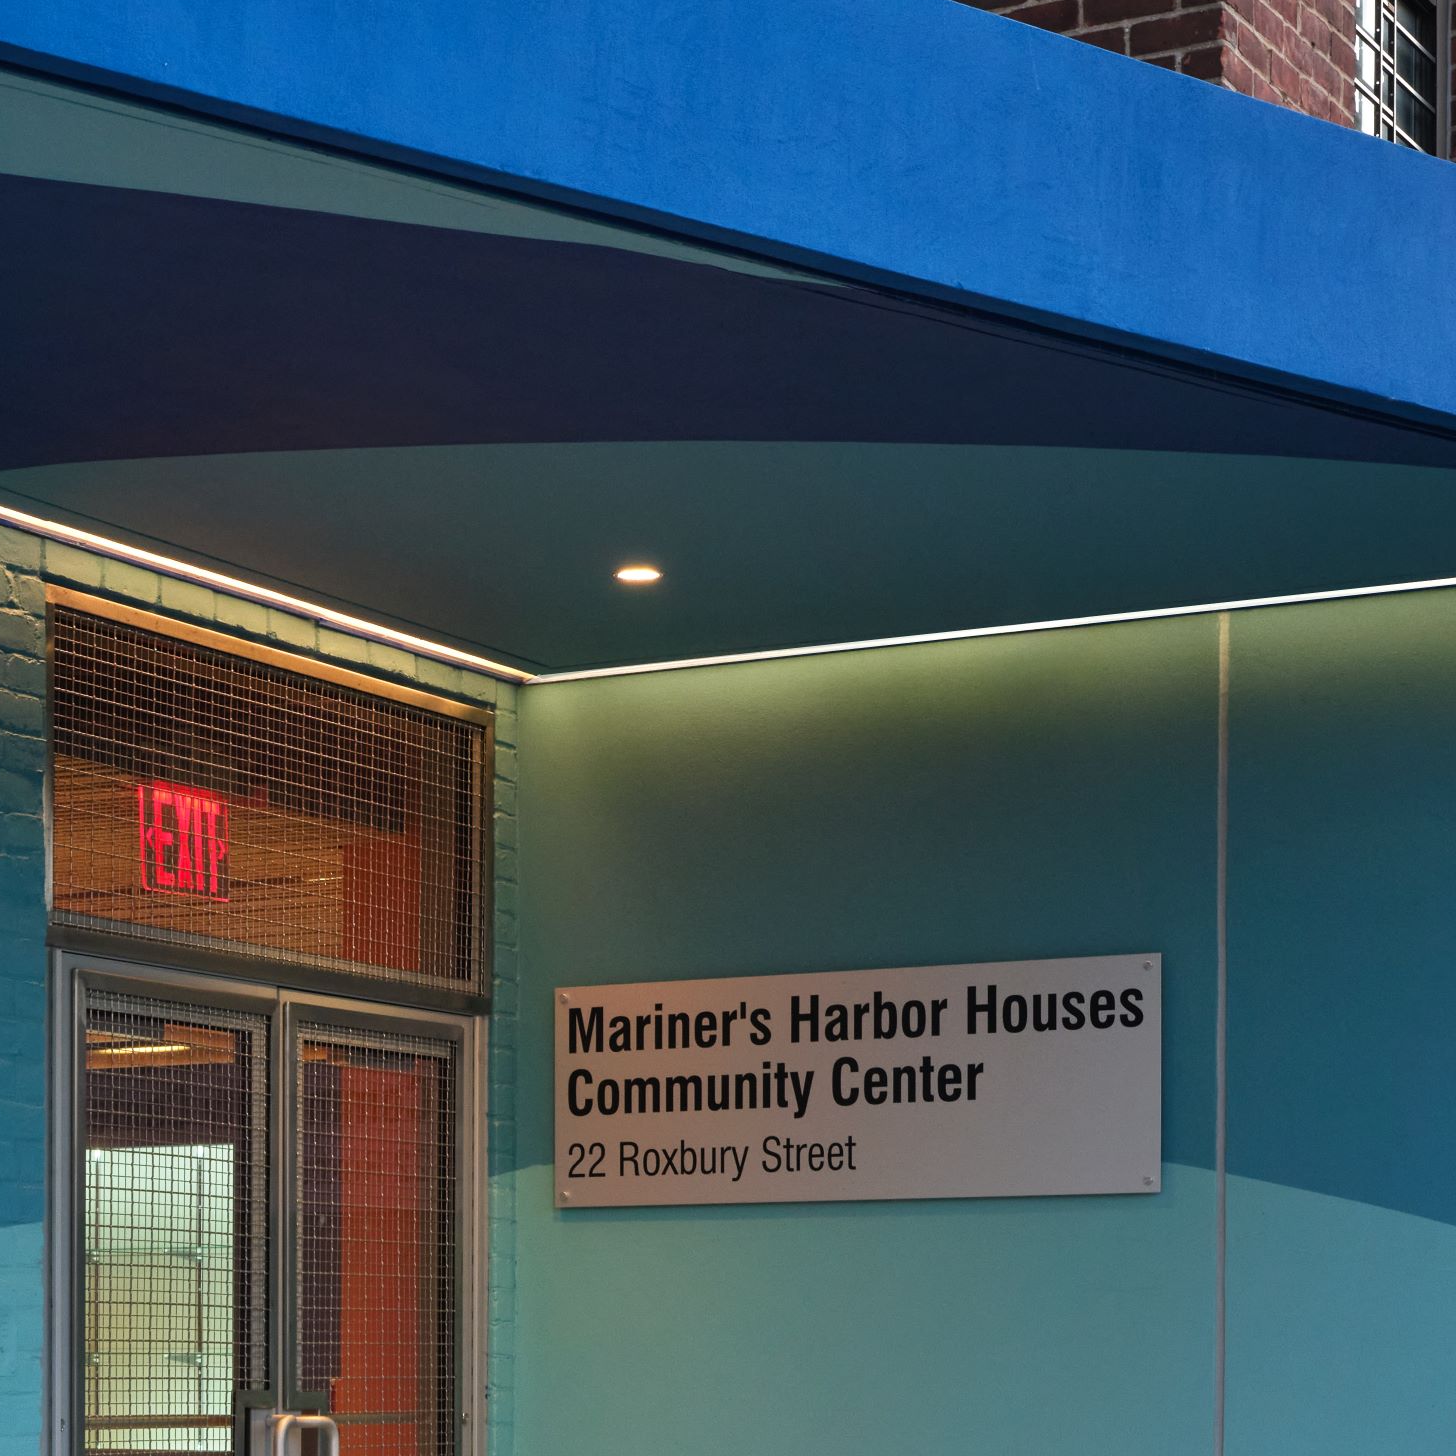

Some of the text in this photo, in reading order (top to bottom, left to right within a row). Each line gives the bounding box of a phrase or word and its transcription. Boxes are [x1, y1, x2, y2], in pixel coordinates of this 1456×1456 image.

[153, 789, 221, 894] EXIT
[568, 984, 1144, 1054] Mariner's Harbor Houses
[567, 1055, 984, 1120] Community Center
[568, 1135, 857, 1182] 22 Roxbury Street
